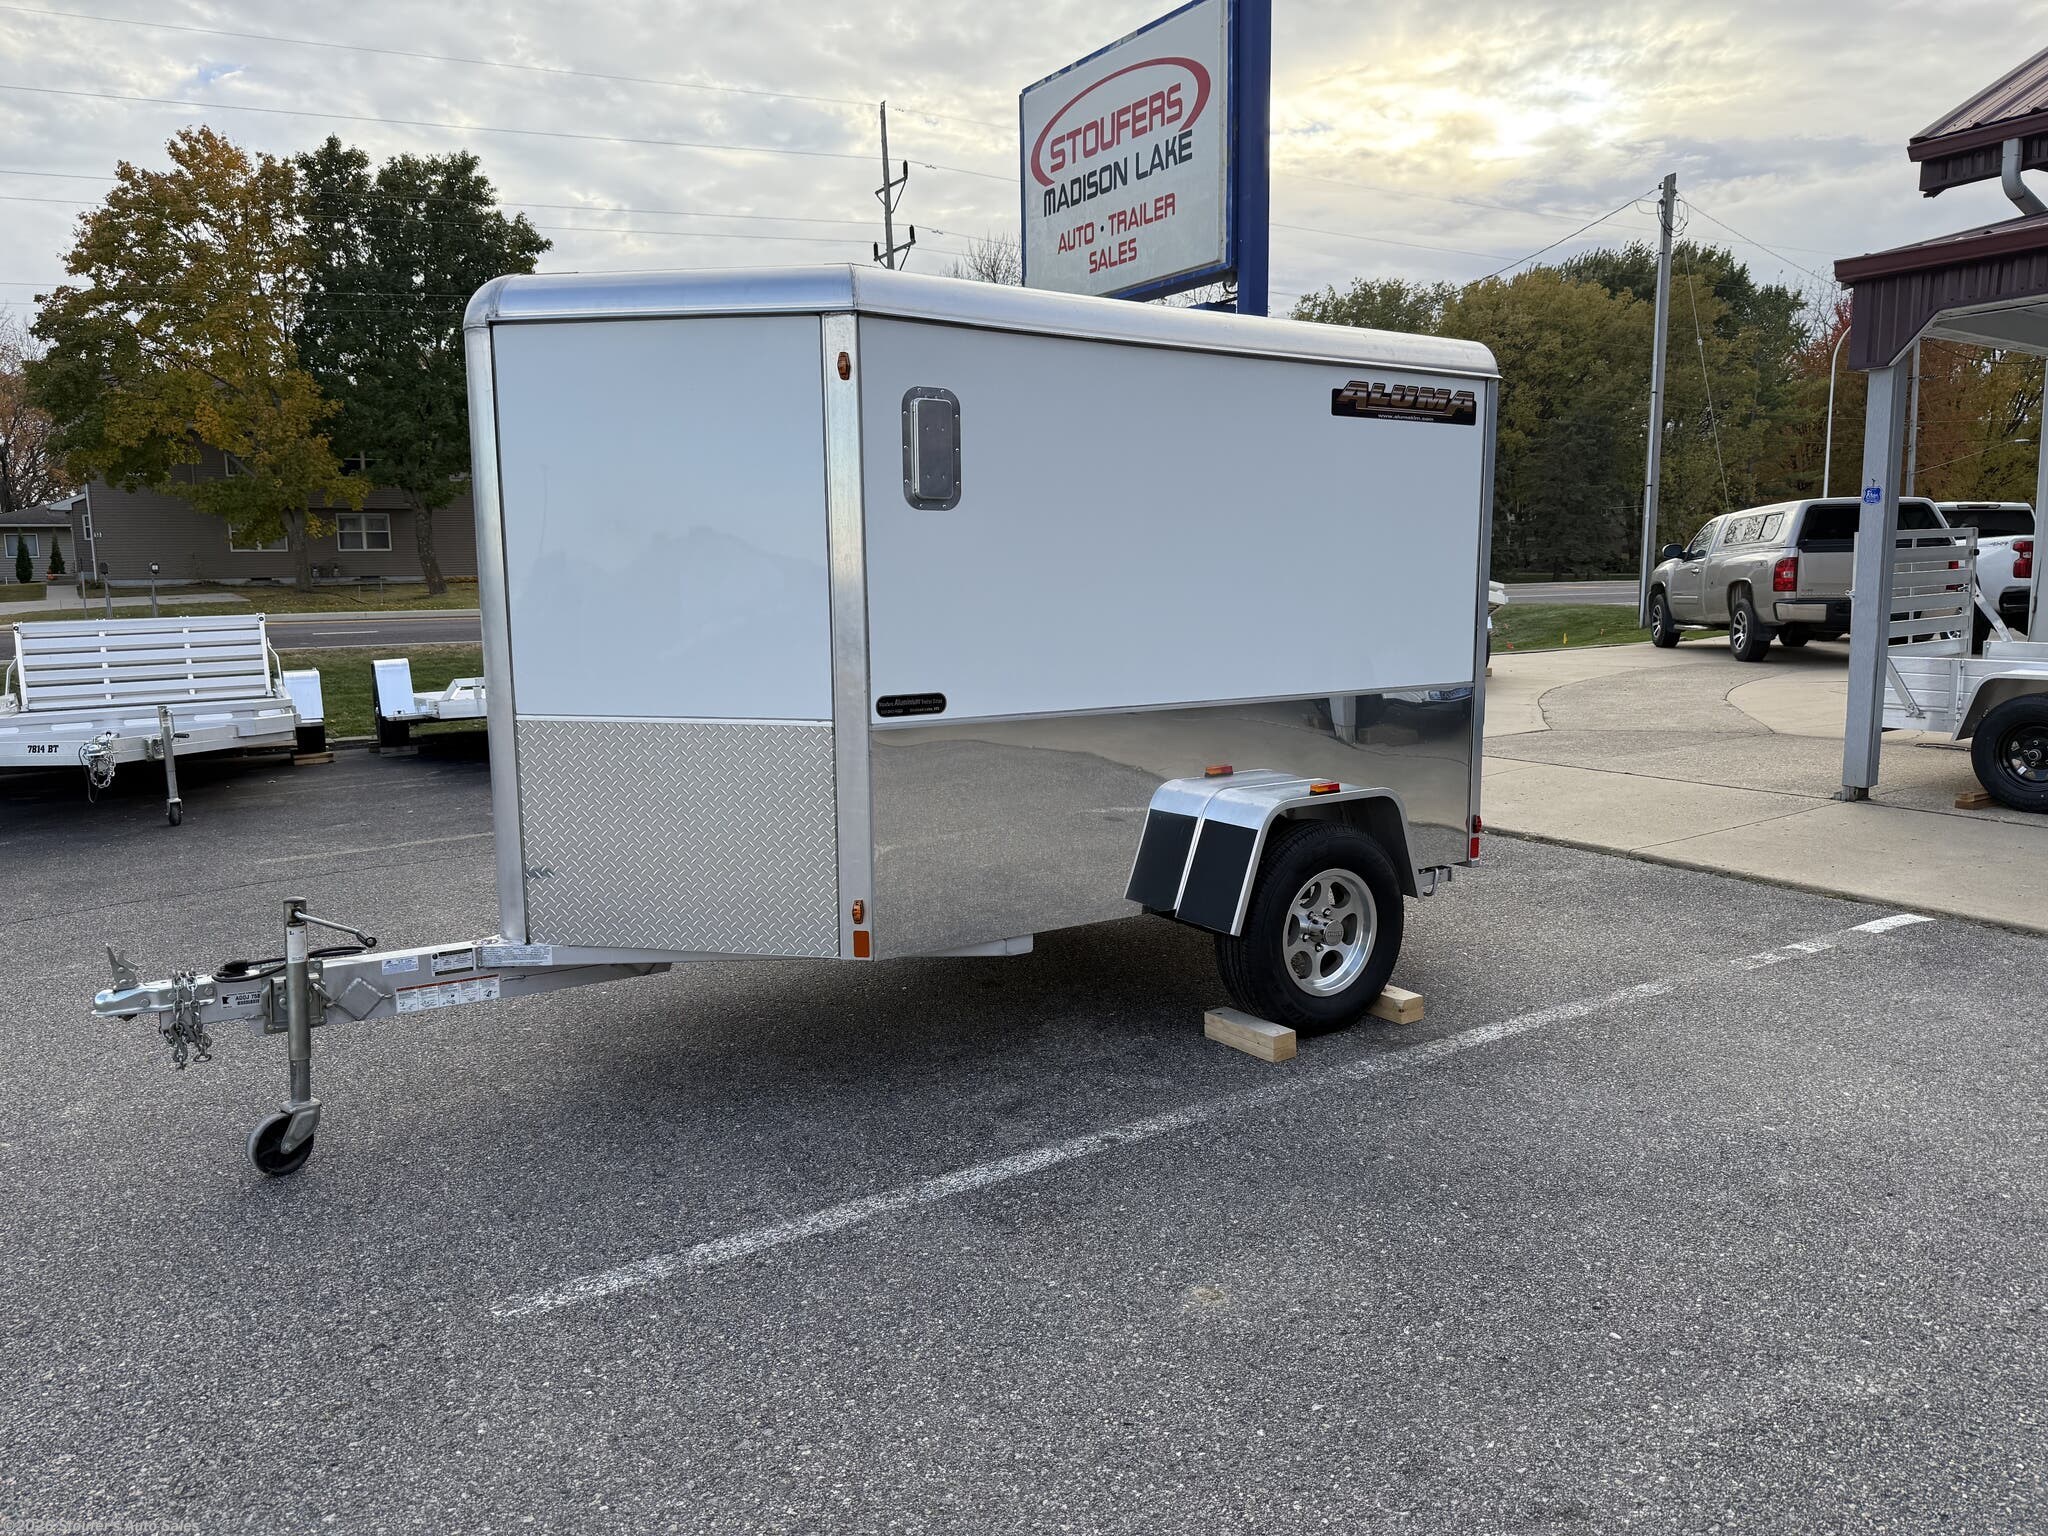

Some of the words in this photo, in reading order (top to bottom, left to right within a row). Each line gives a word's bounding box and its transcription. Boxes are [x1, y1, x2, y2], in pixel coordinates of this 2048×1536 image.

[1050, 83, 1183, 174] STOUFERS
[1043, 156, 1128, 217] MADISON
[1135, 129, 1193, 180] LAKE
[1057, 222, 1095, 255] AUTO
[1108, 192, 1176, 236] TRAILER
[1089, 238, 1137, 274] SALES
[1336, 380, 1475, 416] ALUMA
[27, 744, 45, 753] 7814
[47, 744, 59, 753] BT
